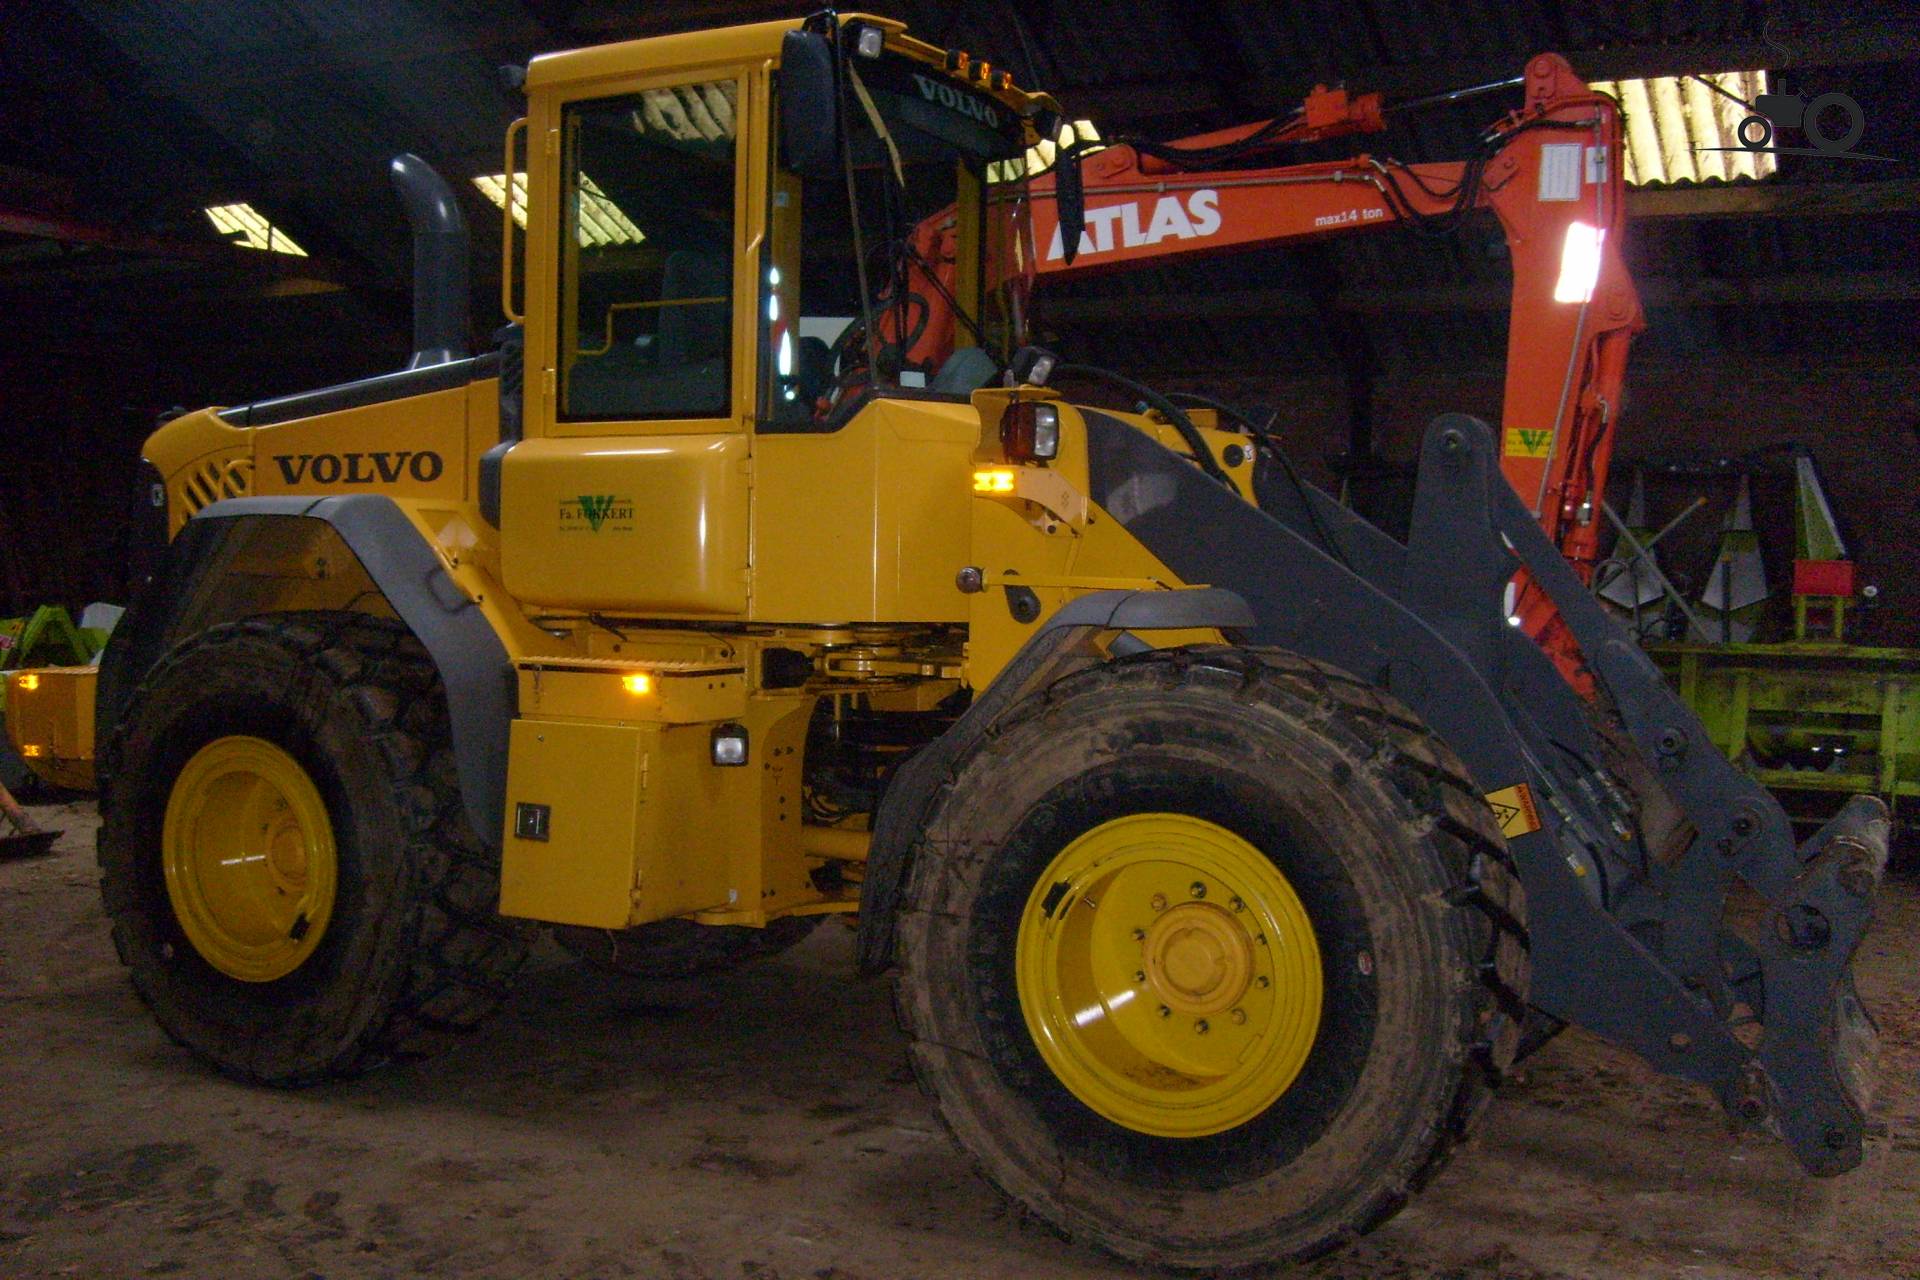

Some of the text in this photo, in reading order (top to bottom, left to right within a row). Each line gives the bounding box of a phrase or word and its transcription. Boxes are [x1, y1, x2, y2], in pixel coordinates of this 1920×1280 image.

[911, 73, 999, 129] VOLVO
[1362, 208, 1383, 220] ton
[272, 450, 444, 485] VOLVO
